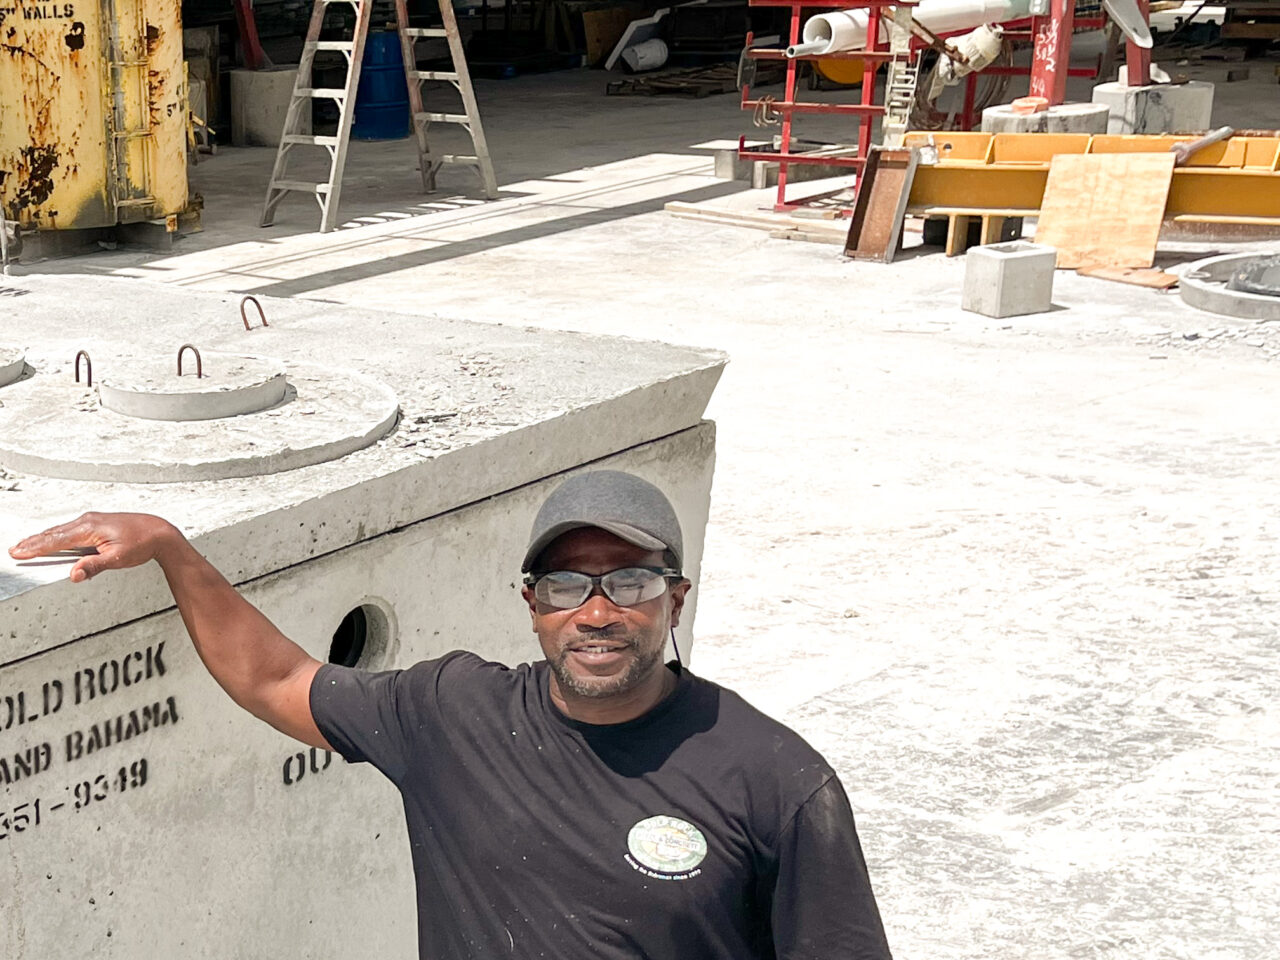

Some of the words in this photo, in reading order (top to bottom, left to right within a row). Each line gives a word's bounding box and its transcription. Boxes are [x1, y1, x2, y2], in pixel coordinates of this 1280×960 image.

[22, 4, 74, 20] WALLS
[75, 640, 166, 705] ROCK
[66, 696, 179, 762] BAHAMA
[283, 747, 332, 786] OU
